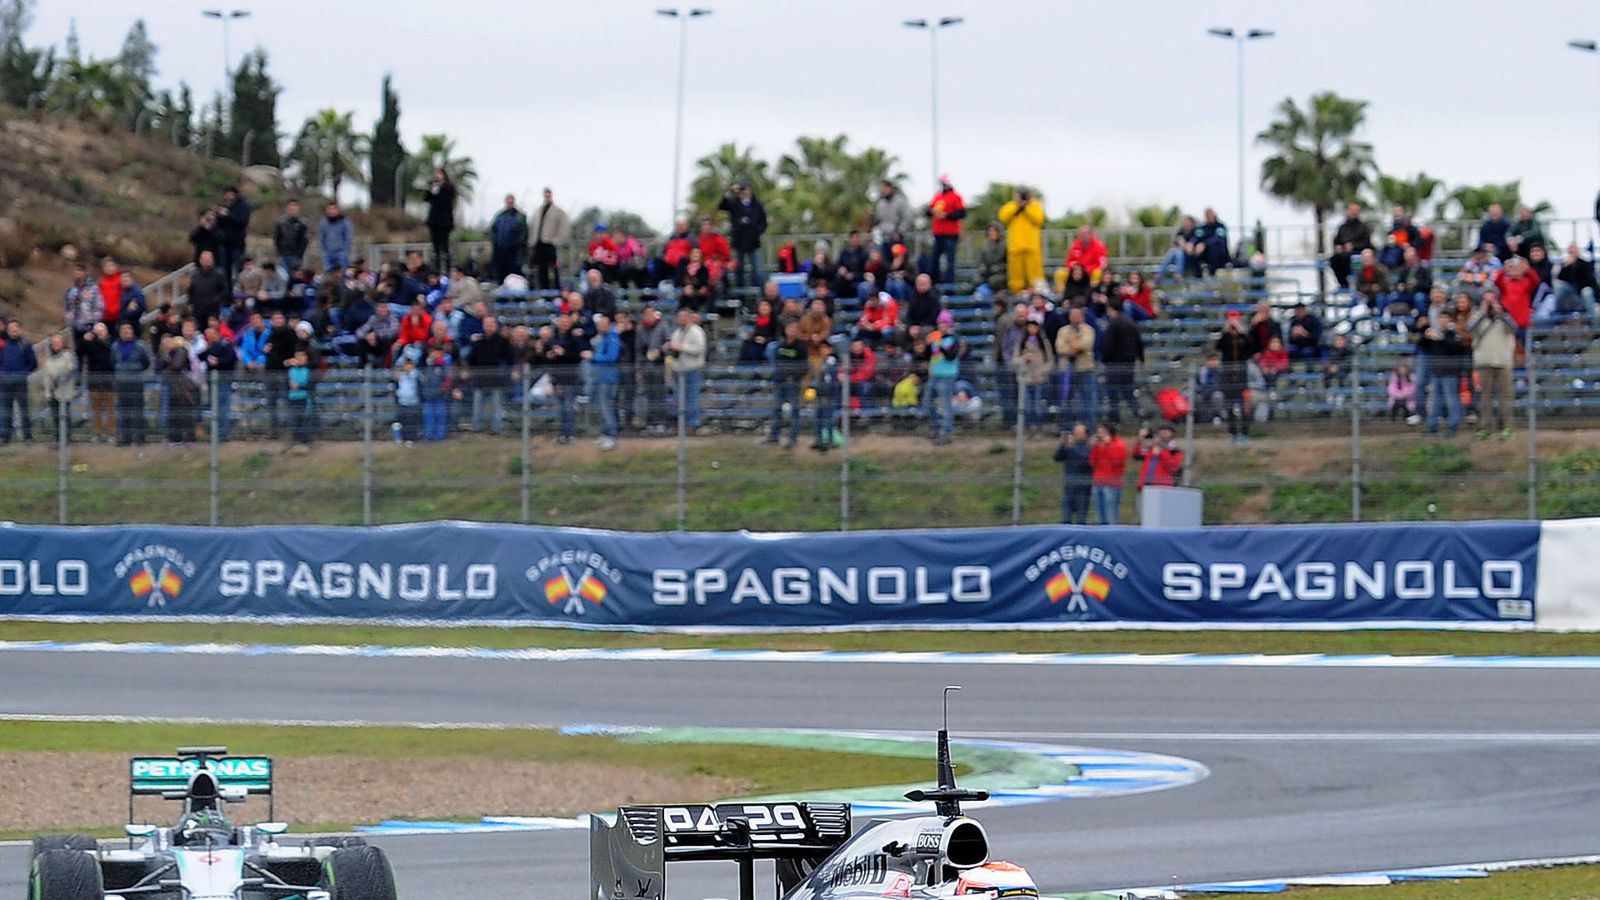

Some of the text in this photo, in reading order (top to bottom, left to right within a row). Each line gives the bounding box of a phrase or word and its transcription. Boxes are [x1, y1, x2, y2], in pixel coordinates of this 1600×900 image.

[218, 560, 498, 600] SPAGNOLO
[652, 566, 992, 605] SPAGNOLO
[1162, 561, 1522, 600] SPAGNOLO
[918, 834, 941, 849] BOSS
[830, 854, 871, 888] Mobil
